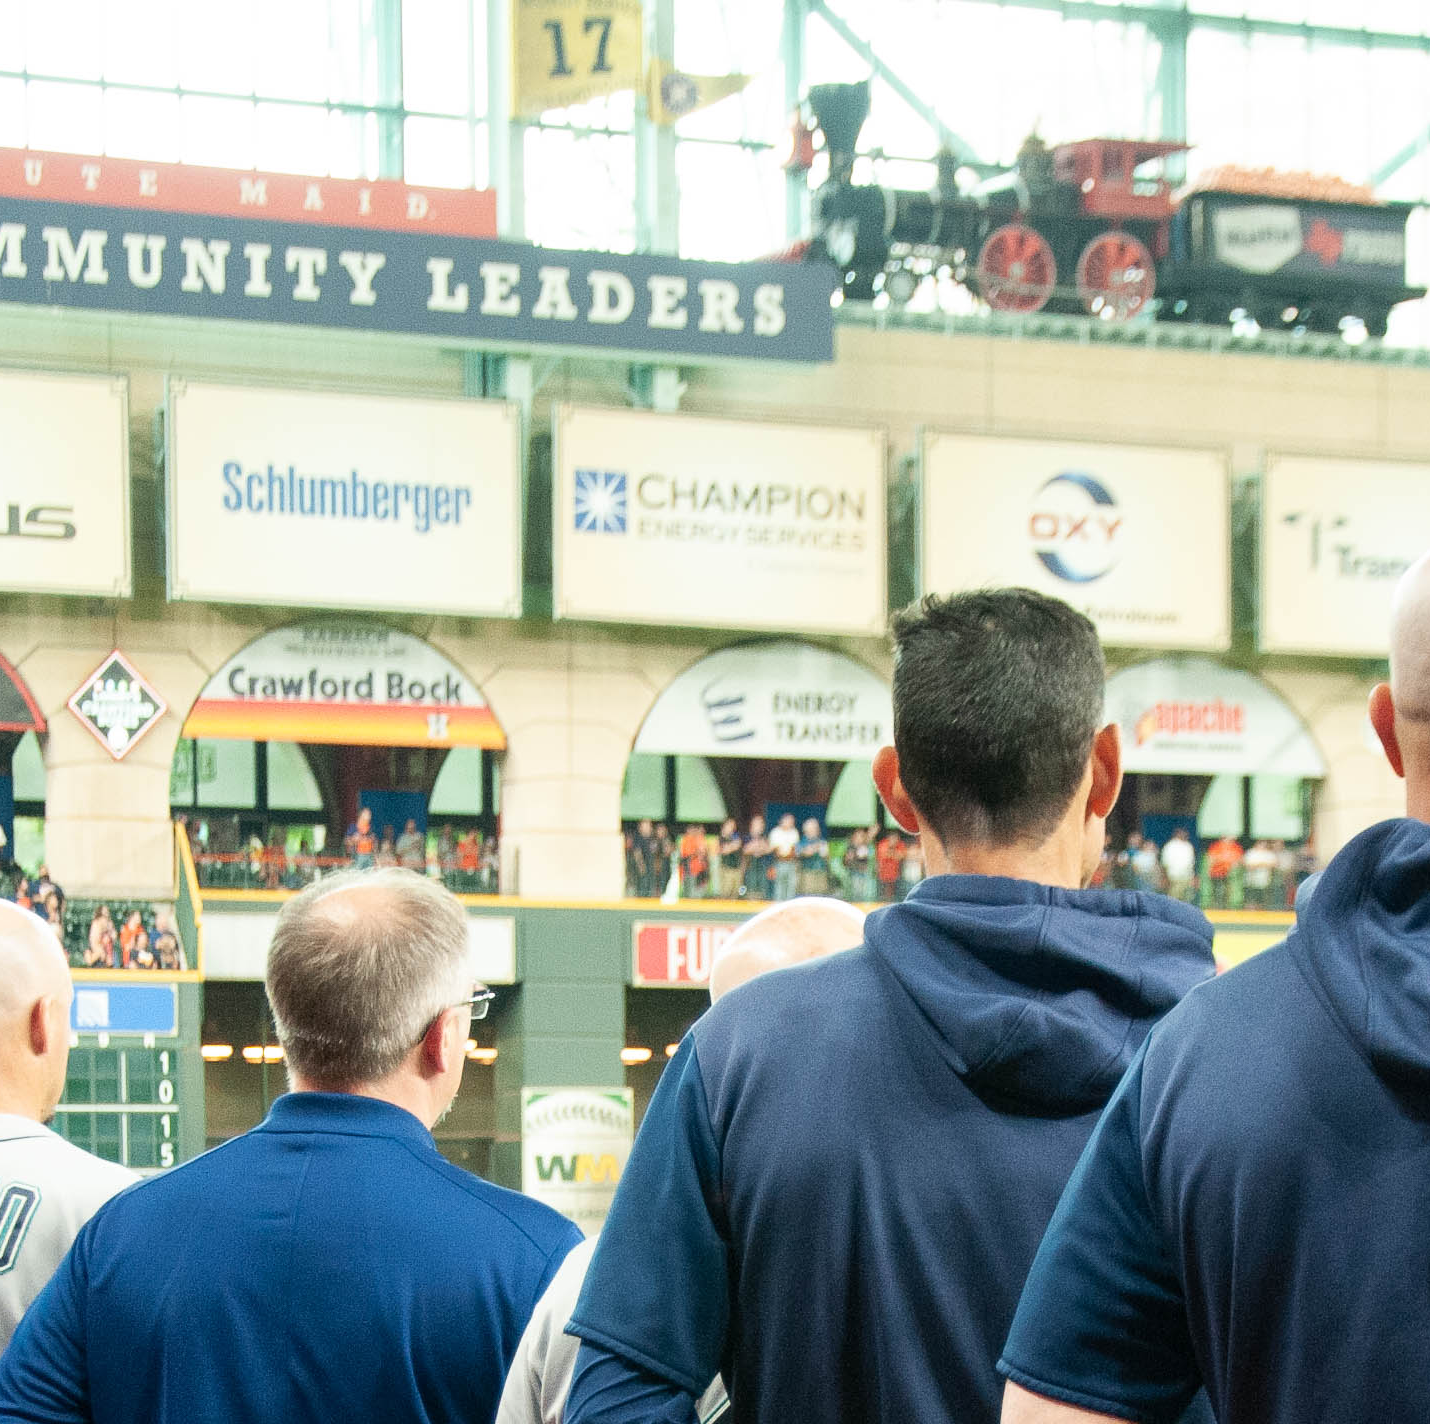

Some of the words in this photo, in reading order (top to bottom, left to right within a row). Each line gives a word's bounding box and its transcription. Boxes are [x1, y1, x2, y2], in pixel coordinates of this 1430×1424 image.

[544, 17, 615, 78] 17
[427, 257, 787, 337] LEADERS
[222, 460, 471, 533] Schlumberger
[637, 473, 866, 522] CHAMPION
[1029, 512, 1123, 543] OXY
[228, 667, 373, 701] Crawford
[386, 673, 462, 706] Bock
[773, 692, 859, 719] ENERGY
[1154, 698, 1245, 735] apache
[159, 1051, 170, 1075] 1
[159, 1080, 173, 1104] 0
[161, 1114, 171, 1139] 1
[160, 1142, 174, 1167] 5
[535, 1153, 620, 1183] WM
